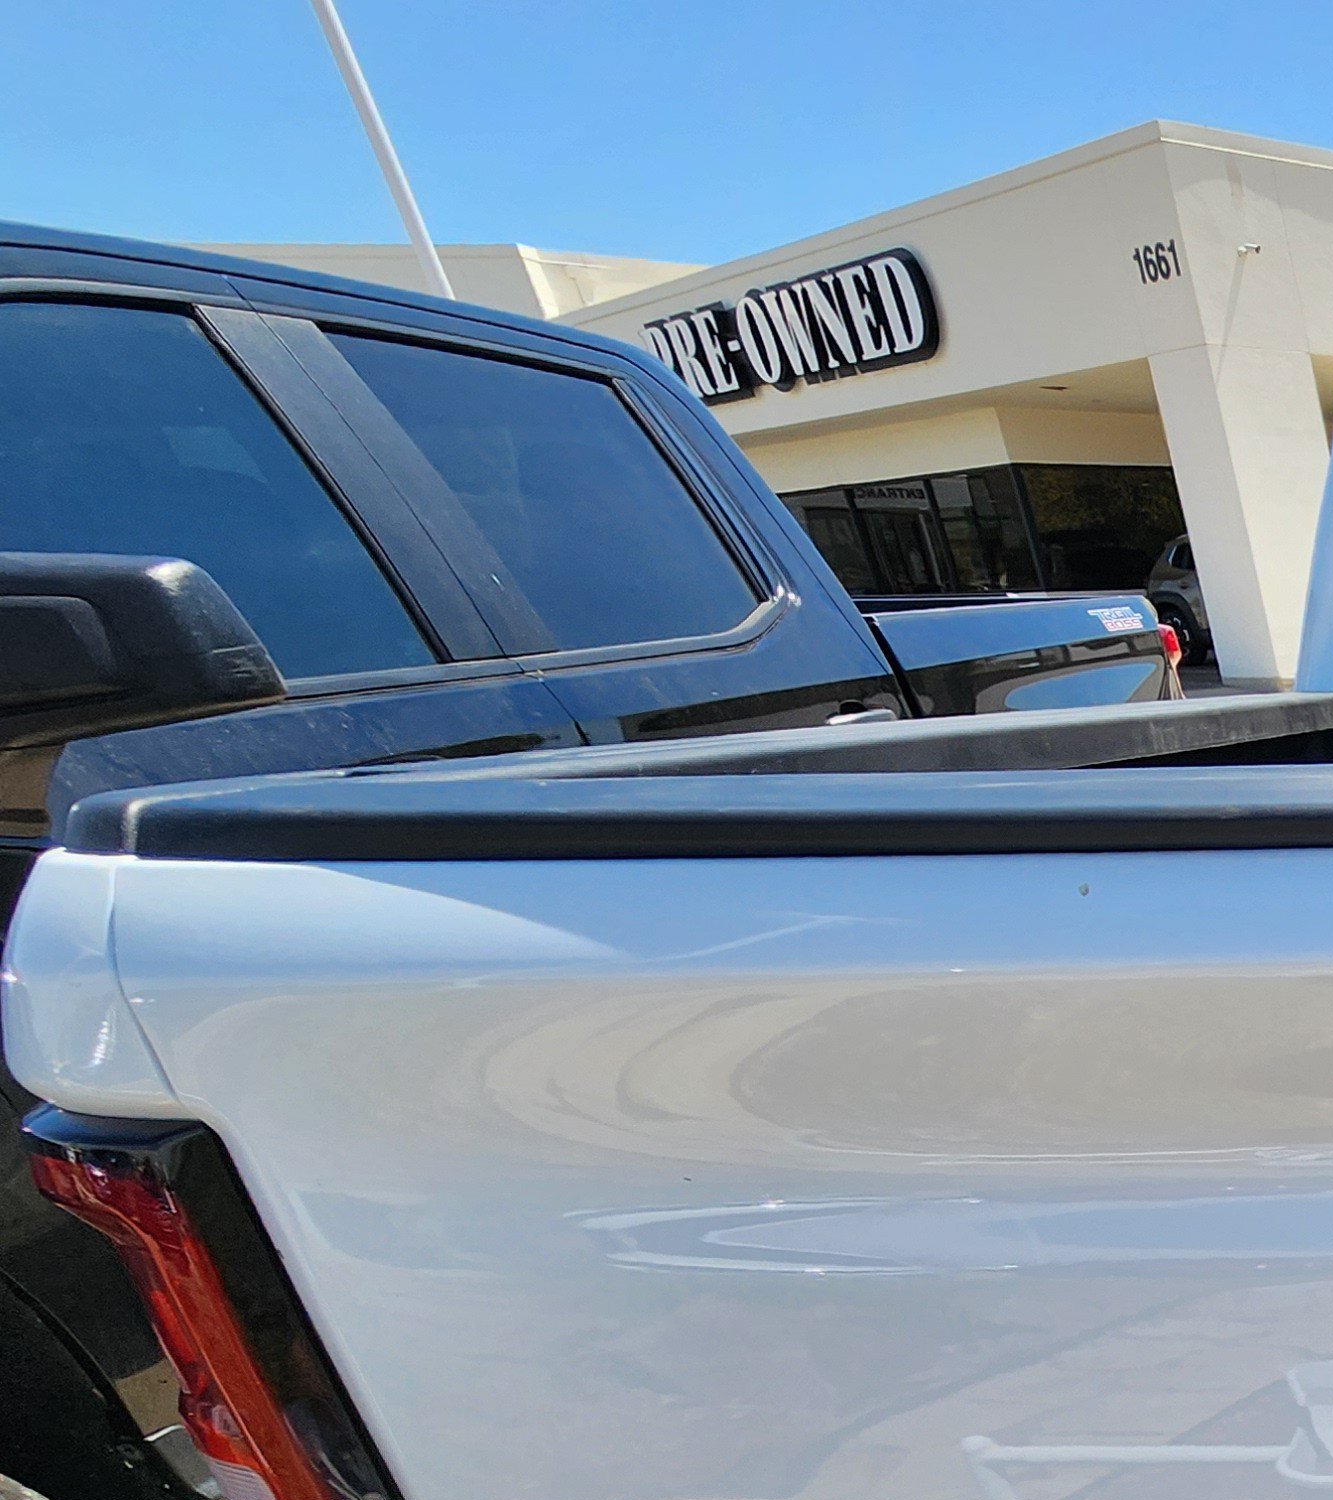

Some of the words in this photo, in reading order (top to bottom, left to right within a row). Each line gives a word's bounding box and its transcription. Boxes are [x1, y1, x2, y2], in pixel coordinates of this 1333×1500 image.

[1133, 239, 1181, 285] 1661
[640, 256, 925, 398] PRE-OWNED
[1087, 606, 1144, 621] TRAIL
[1105, 619, 1144, 632] BOSS
